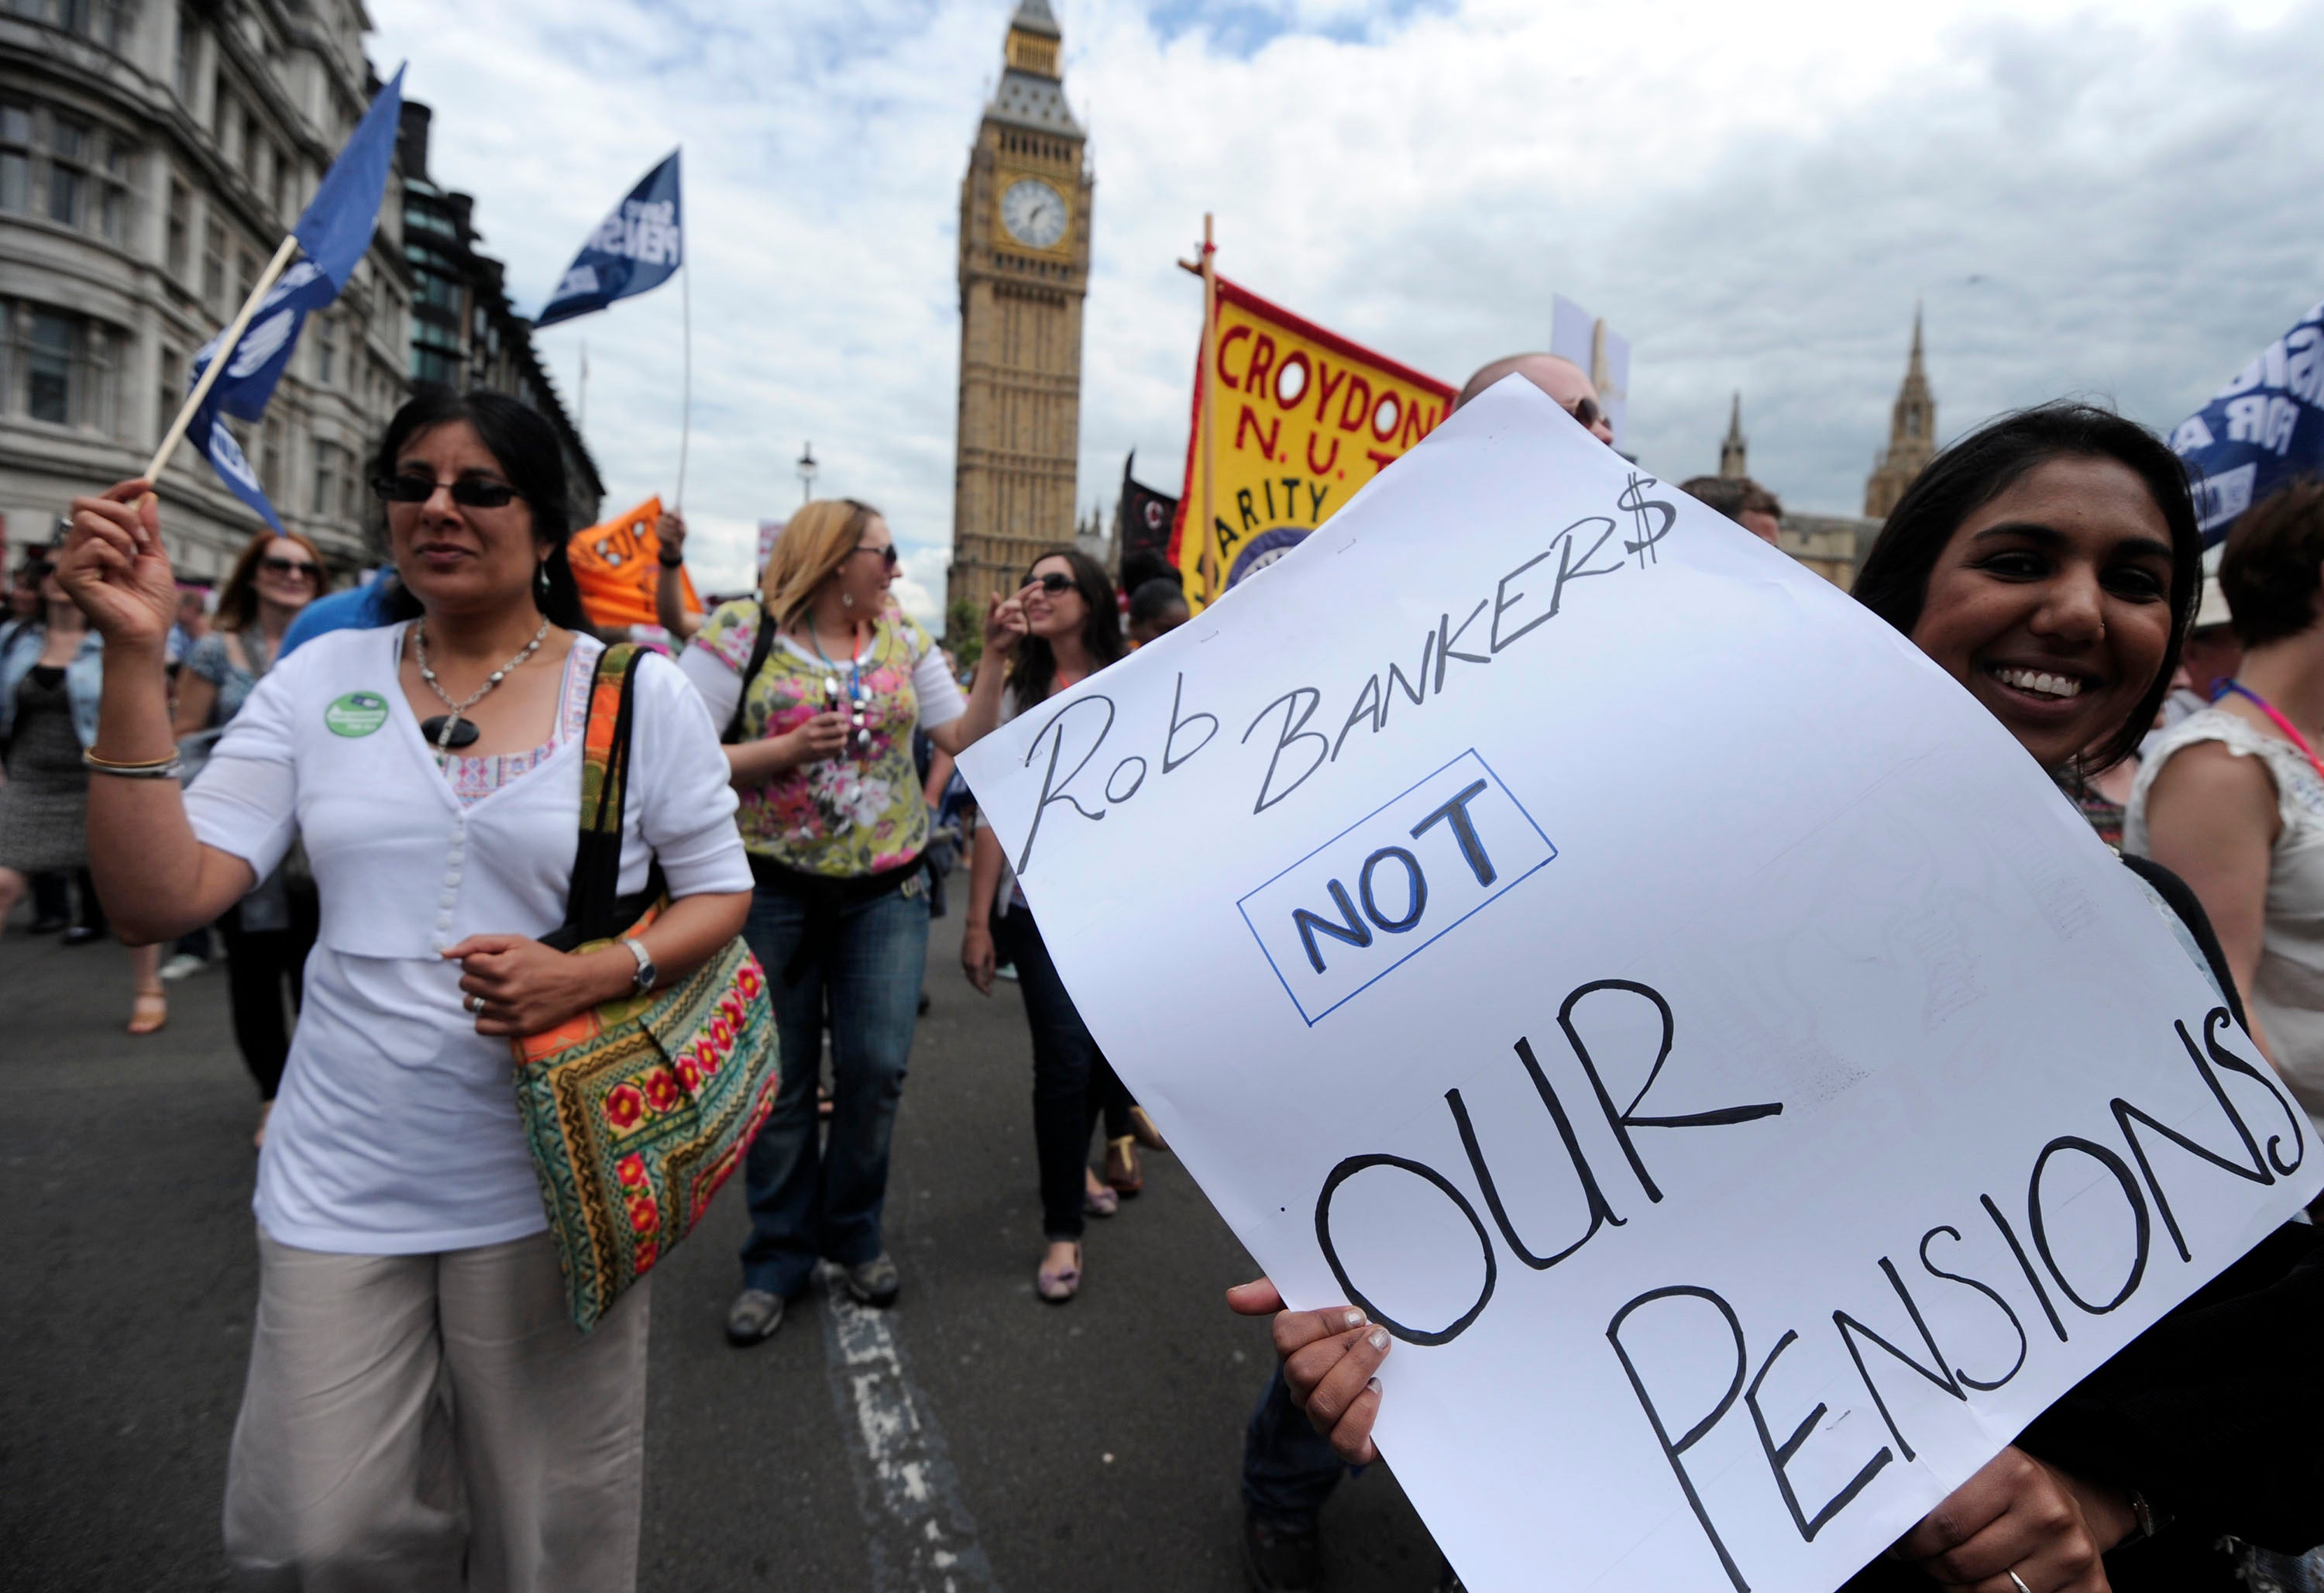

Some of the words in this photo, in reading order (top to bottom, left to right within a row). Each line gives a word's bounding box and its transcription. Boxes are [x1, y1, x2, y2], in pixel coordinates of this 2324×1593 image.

[1217, 324, 1436, 449] CROYDON
[1016, 672, 1219, 876] Rob
[1241, 471, 1676, 814] BANKER$
[1292, 779, 1497, 974] NOT
[1315, 979, 1783, 1347] OUR
[1606, 1006, 2305, 1593] PENSIONS
